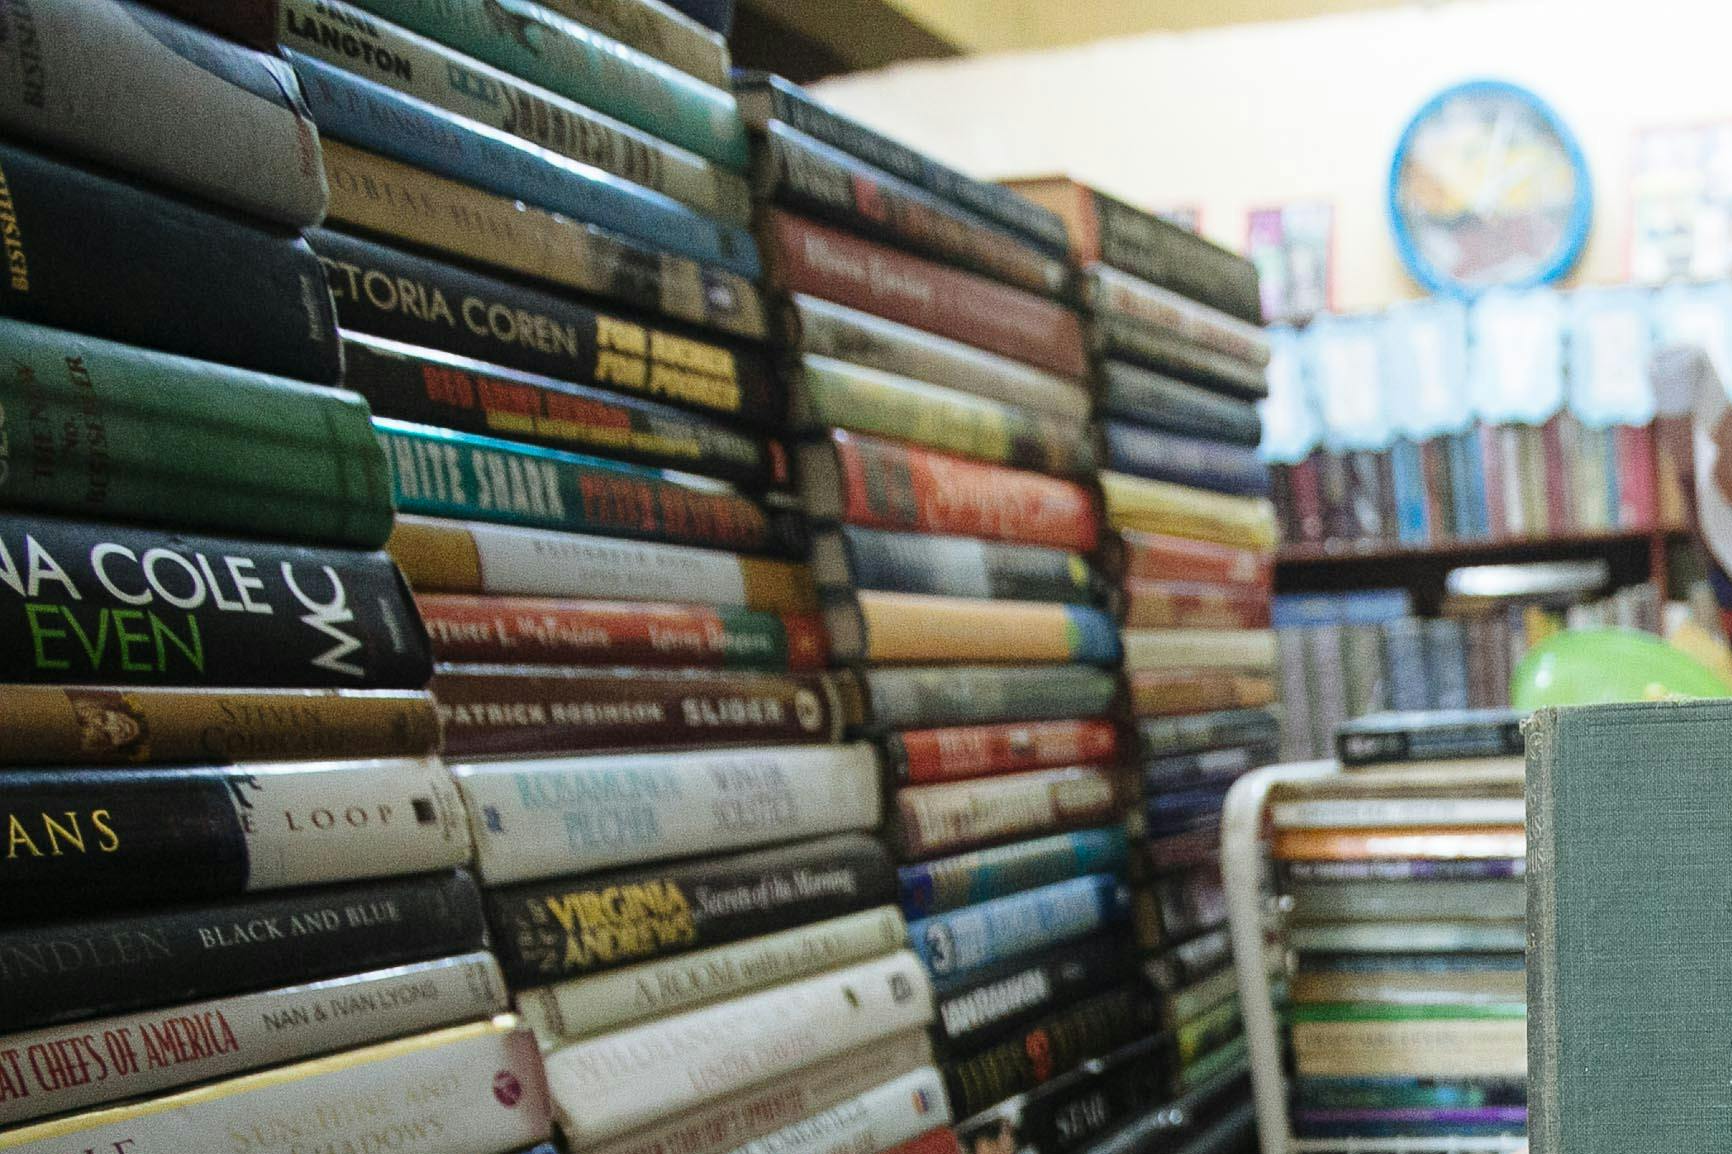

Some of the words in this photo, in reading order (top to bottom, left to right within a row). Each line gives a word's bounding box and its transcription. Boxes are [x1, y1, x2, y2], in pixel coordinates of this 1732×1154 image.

[287, 9, 413, 81] LANGTON
[323, 256, 456, 329] CTORIA
[462, 297, 579, 359] COREN
[90, 541, 274, 615] COLE
[25, 603, 206, 674] EVEN
[440, 701, 547, 728] PATRICK
[551, 703, 665, 725] ROBINSON
[681, 696, 782, 728] SLIDER
[6, 807, 122, 859] ANS
[286, 803, 397, 834] LOOP
[199, 918, 282, 951] BLACK
[290, 907, 338, 937] AND
[346, 898, 400, 926] BLUE
[546, 876, 692, 932] VIRGINIA
[27, 1032, 110, 1095] CHEFS
[104, 1026, 140, 1077] OF
[140, 1009, 240, 1069] AMERICA
[262, 1003, 312, 1034] NAN
[312, 1001, 328, 1026] &
[331, 988, 380, 1022] IVAN
[377, 976, 440, 1014] LYONS
[400, 1072, 463, 1110] AND
